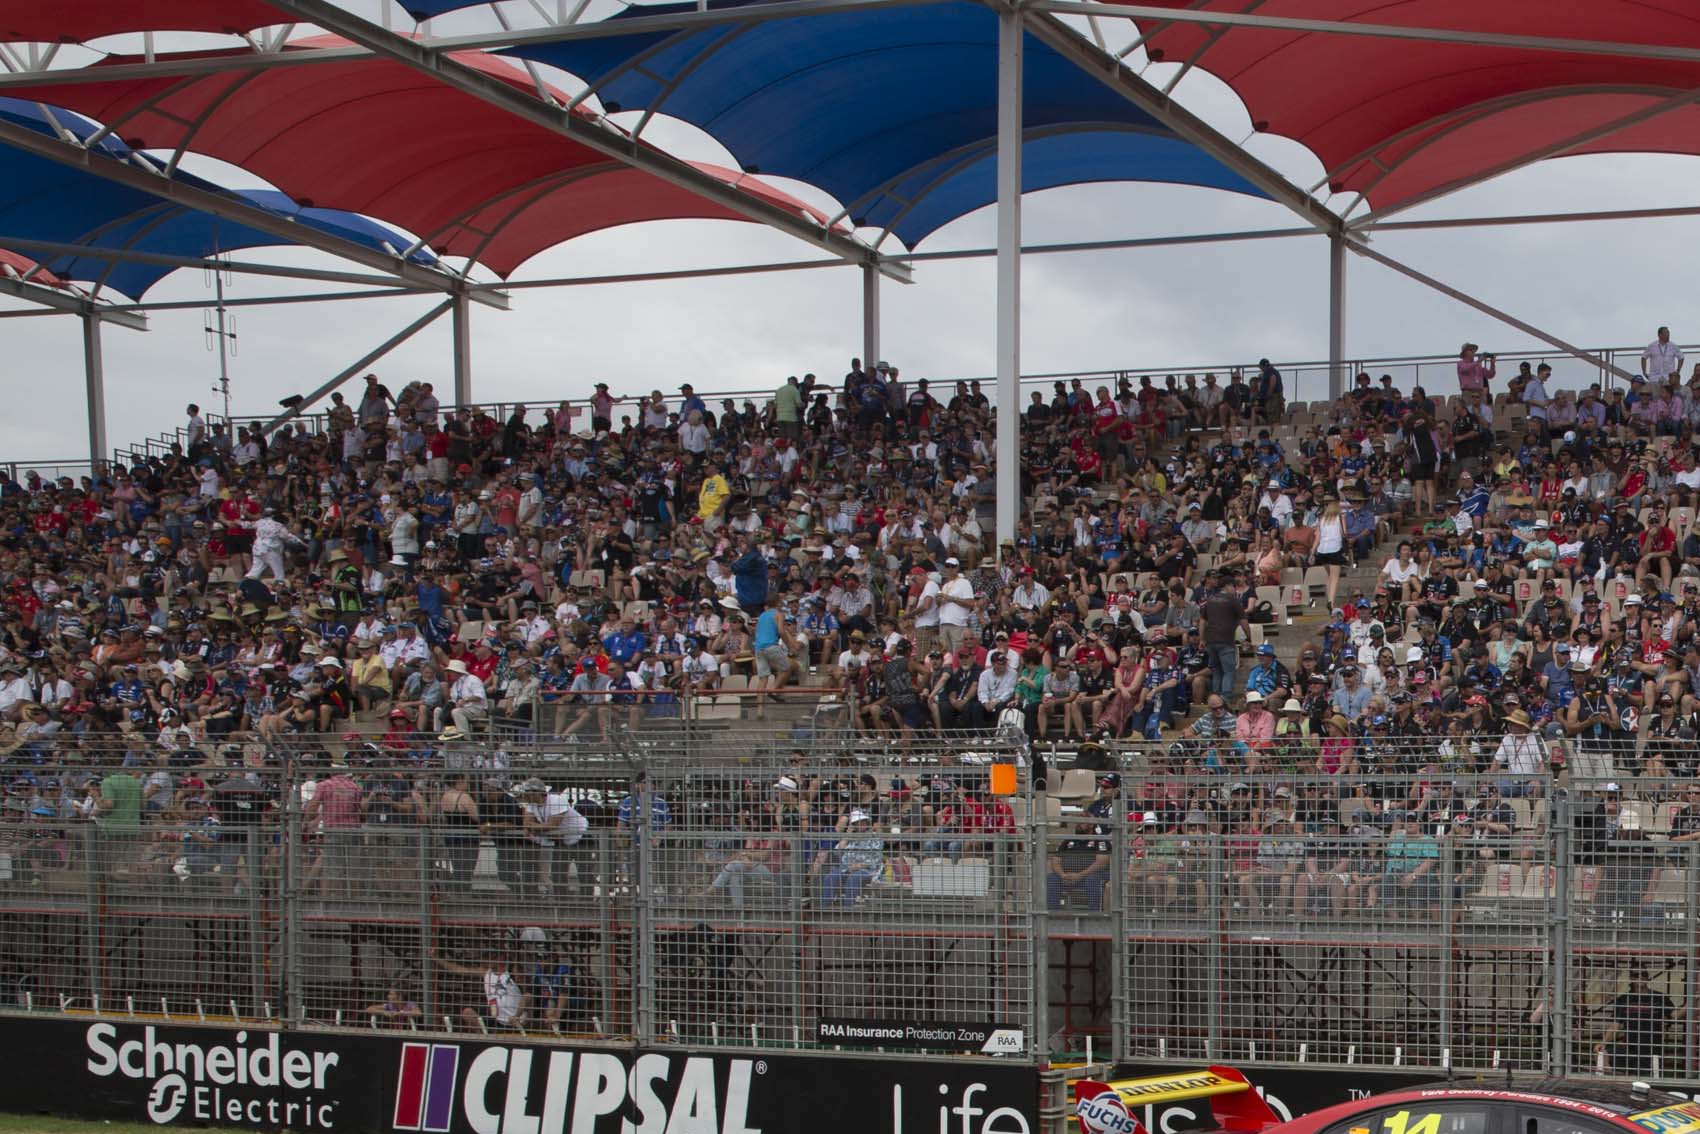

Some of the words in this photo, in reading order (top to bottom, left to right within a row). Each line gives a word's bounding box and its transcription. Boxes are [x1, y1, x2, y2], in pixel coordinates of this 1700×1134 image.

[821, 1024, 845, 1036] RAA
[847, 1025, 904, 1039] Insurance
[906, 1027, 956, 1041] Protection
[958, 1029, 985, 1041] Zone
[998, 1037, 1017, 1046] RAA
[86, 1022, 340, 1090] Schneider
[1118, 1076, 1222, 1098] DUNLOP
[194, 1084, 335, 1128] Electric
